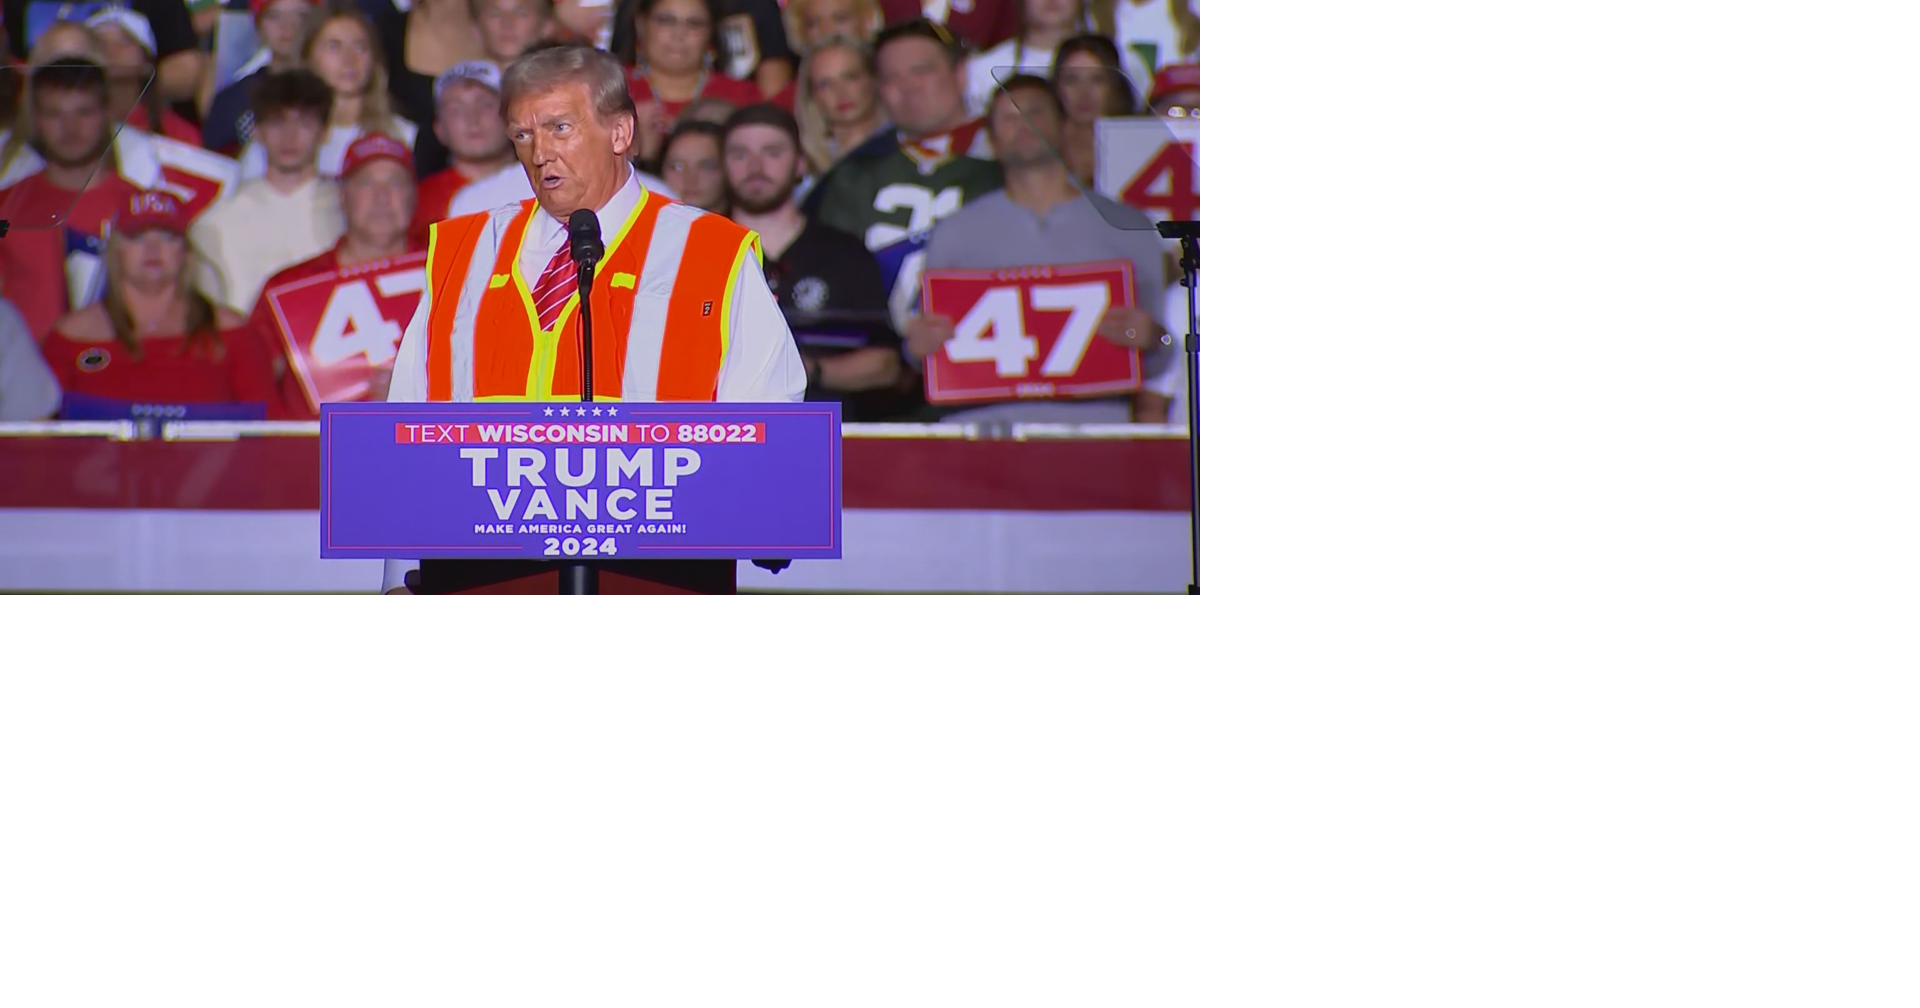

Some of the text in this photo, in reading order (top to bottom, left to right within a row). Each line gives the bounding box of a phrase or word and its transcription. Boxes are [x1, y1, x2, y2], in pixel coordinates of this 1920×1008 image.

[946, 282, 1108, 376] 47
[405, 424, 757, 442] TEXT WISCONSIN TO 88022
[459, 447, 702, 487] TRUMP
[486, 488, 673, 520] VANCE
[474, 524, 687, 534] MAKE AMERICA GREAT AGAIN!
[543, 537, 618, 556] 2024
